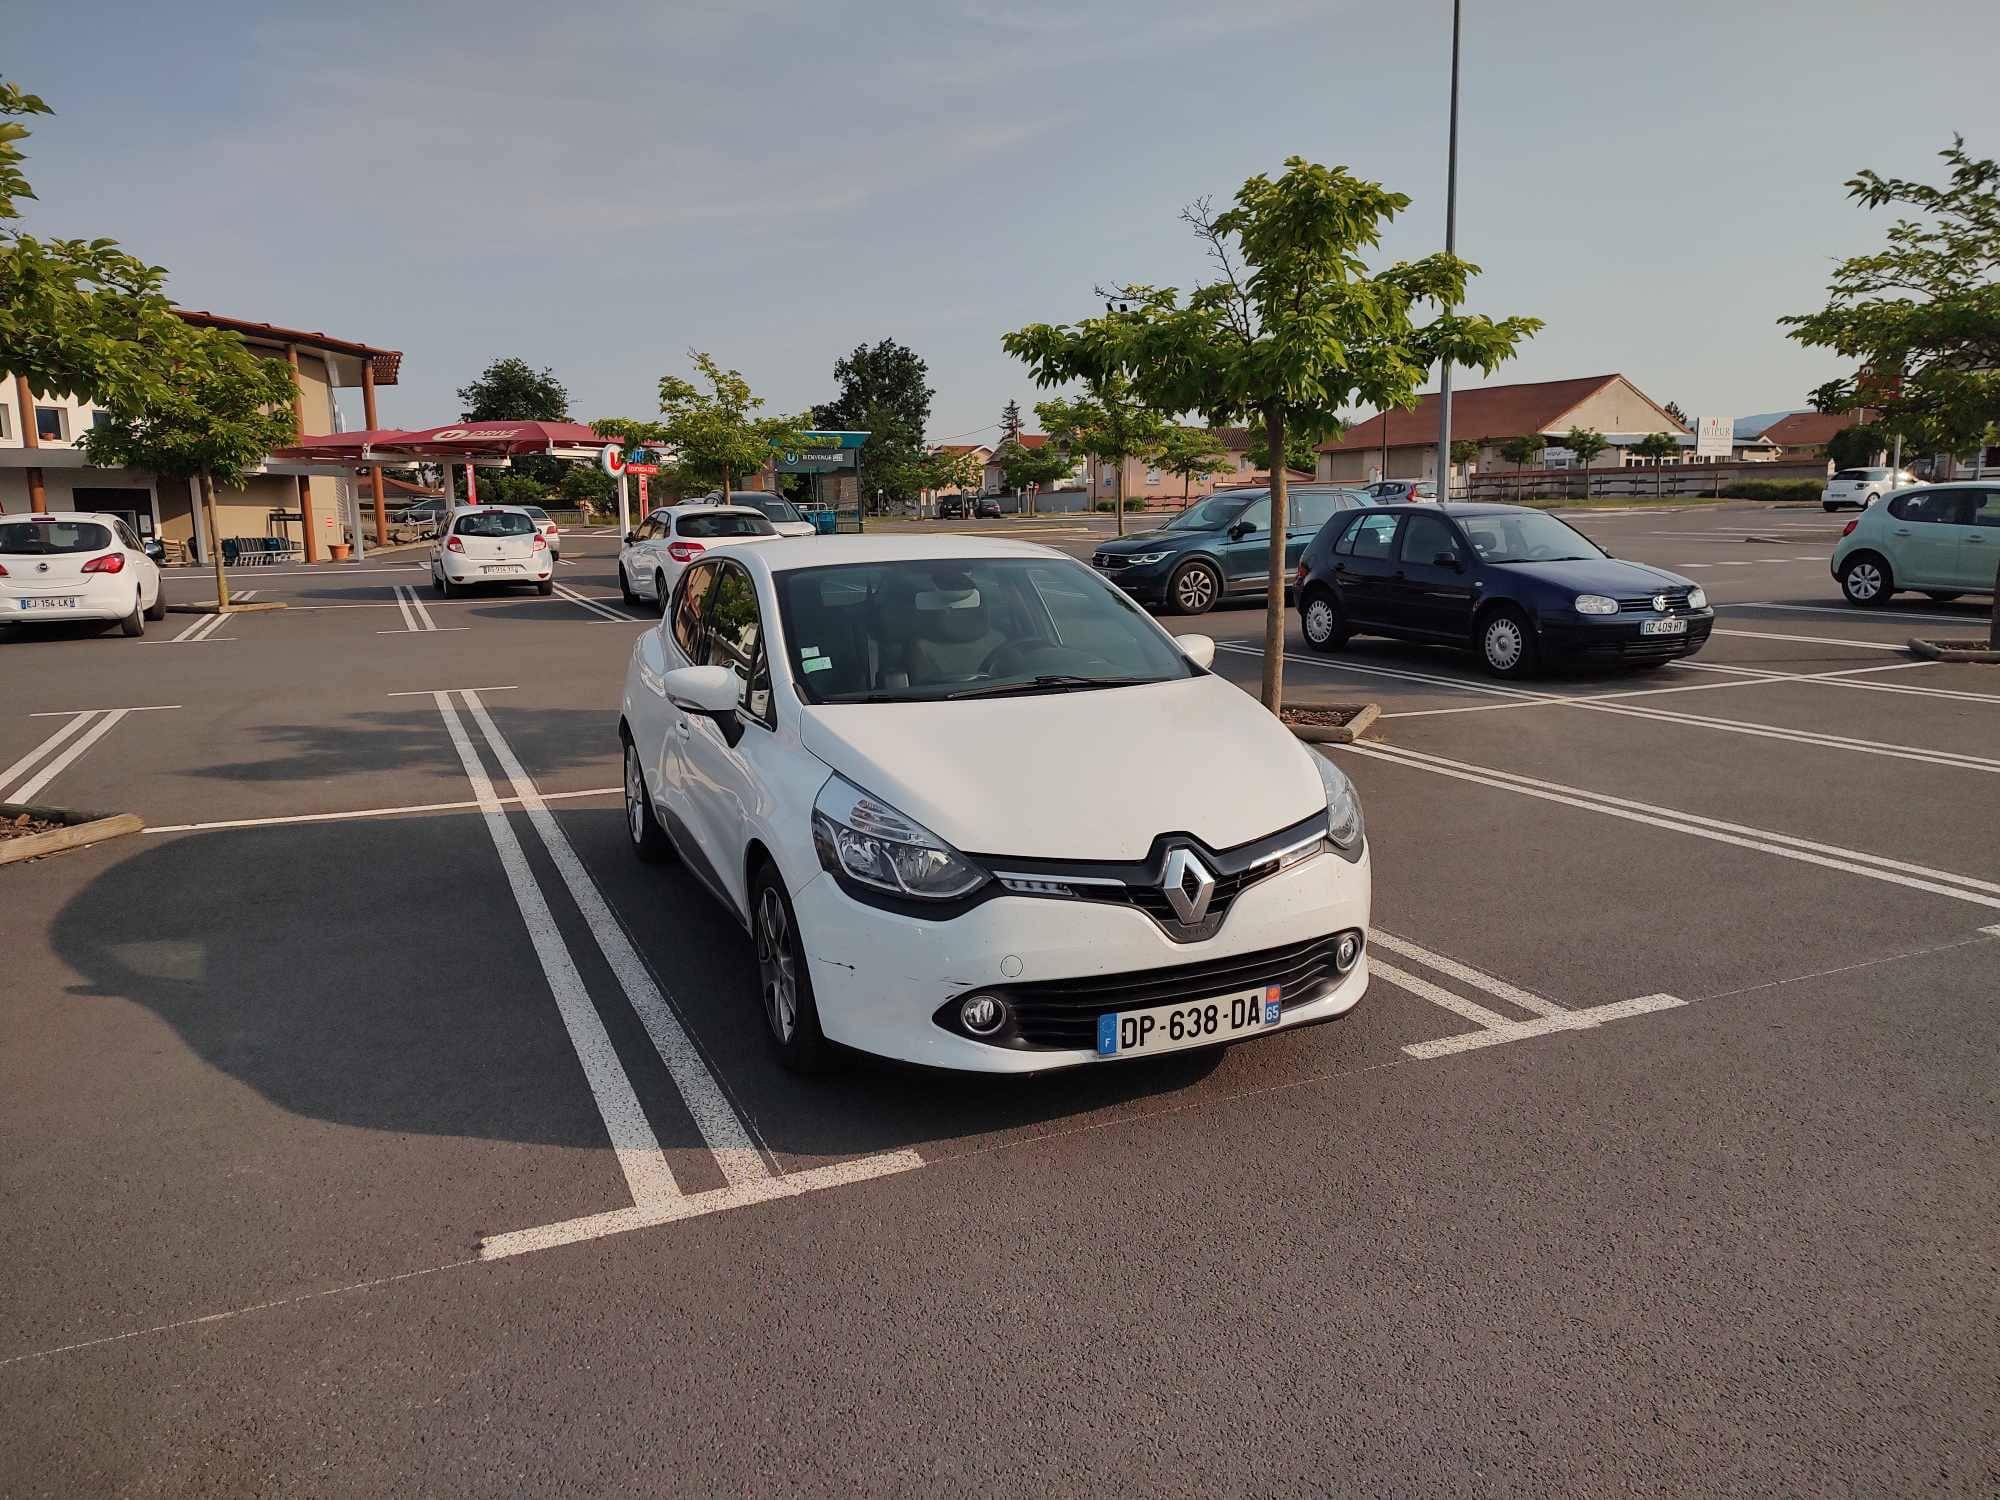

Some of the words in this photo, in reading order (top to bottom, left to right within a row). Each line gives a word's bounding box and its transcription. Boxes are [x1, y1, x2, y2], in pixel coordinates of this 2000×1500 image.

[1265, 1004, 1279, 1020] 65
[1121, 995, 1260, 1049] DP-638-DA
[1104, 1037, 1112, 1048] F
